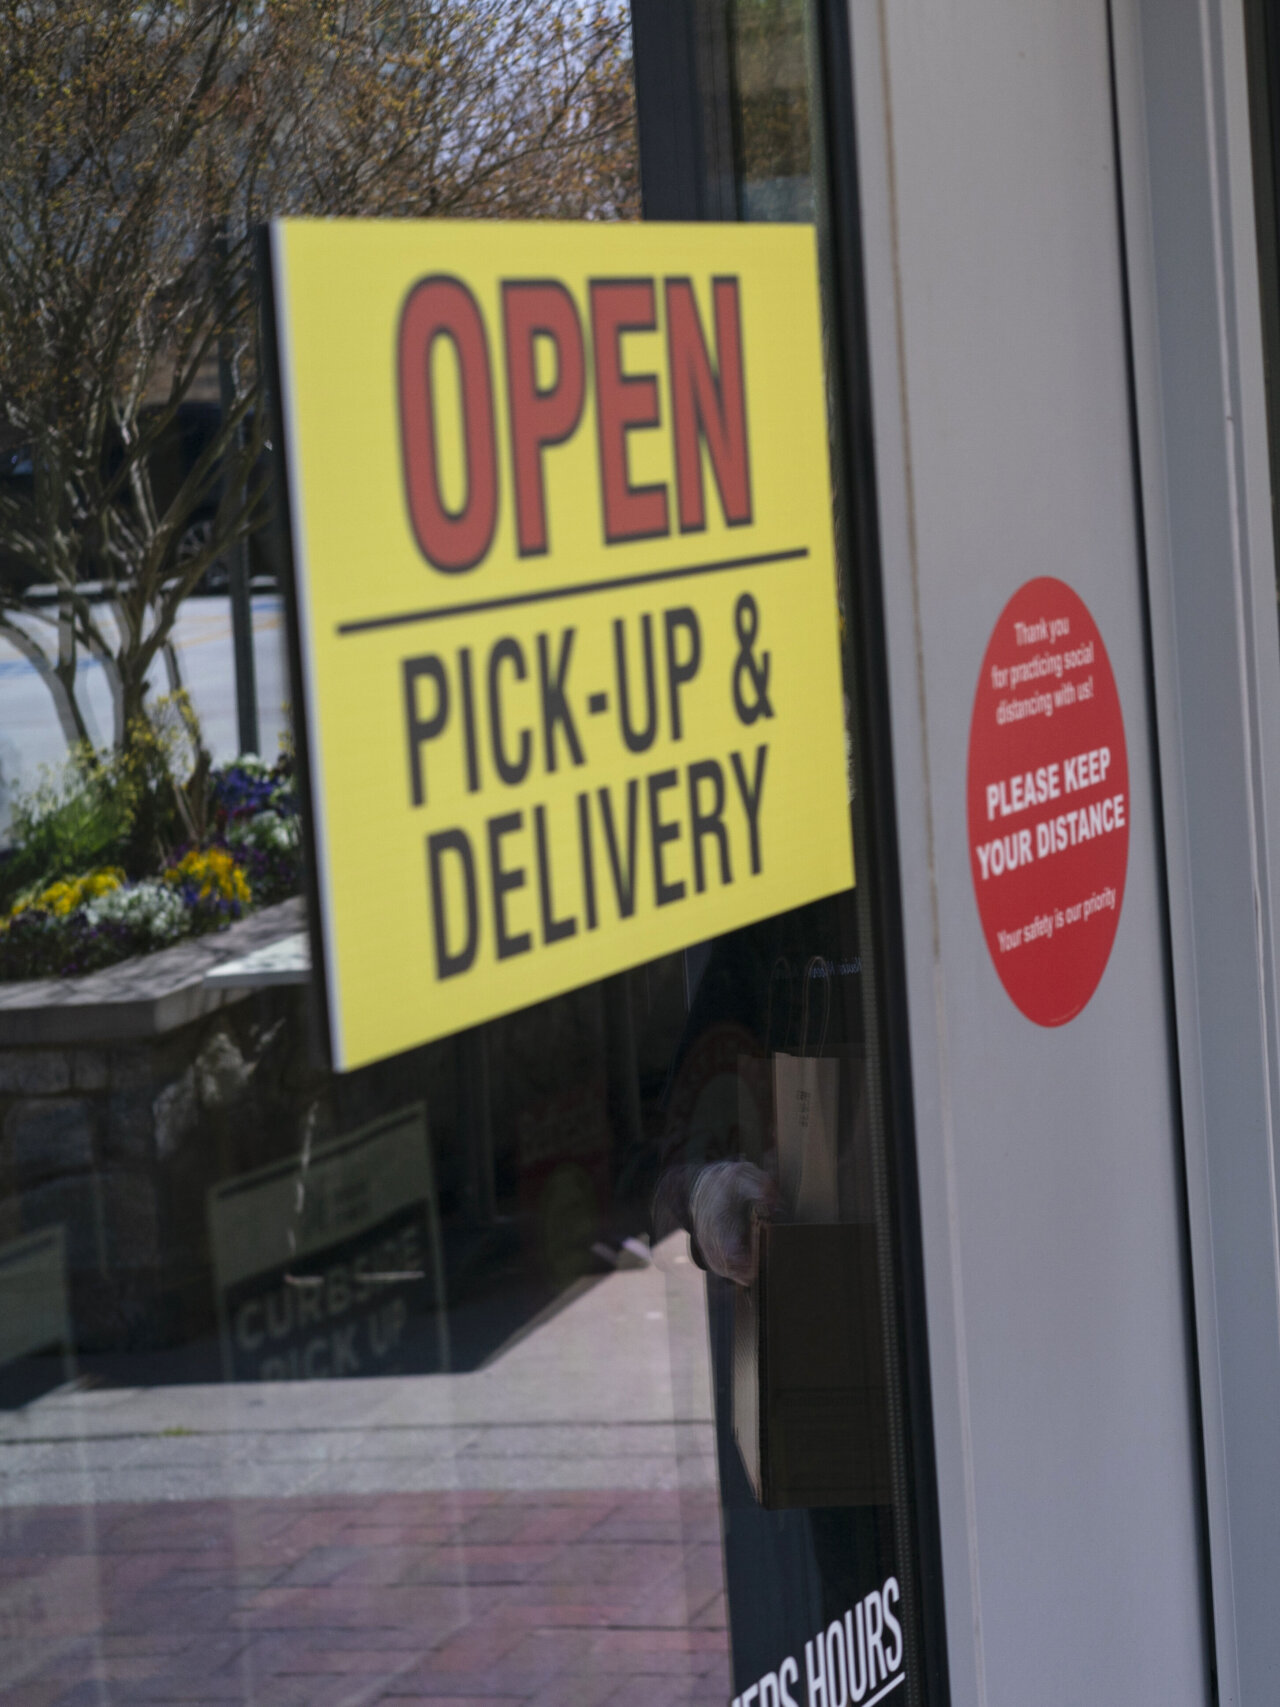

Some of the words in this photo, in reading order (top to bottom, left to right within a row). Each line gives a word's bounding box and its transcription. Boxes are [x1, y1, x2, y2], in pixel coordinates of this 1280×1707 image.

[396, 271, 754, 575] OPEN
[991, 664, 1009, 690] for
[1009, 651, 1063, 691] practicing
[1063, 640, 1094, 670] social
[1013, 616, 1048, 647] Thank
[1048, 616, 1070, 645] you
[402, 605, 702, 809] PICK-UP
[731, 591, 776, 727] &
[996, 690, 1053, 725] distancing
[1053, 681, 1076, 708] with
[1076, 675, 1094, 702] us!
[986, 763, 1061, 822] PLEASE
[1063, 746, 1111, 794] KEEP
[425, 743, 770, 983] DELIVERY
[976, 828, 1034, 881] YOUR
[1036, 793, 1126, 860] DISTANCE
[997, 929, 1023, 953] Your
[1023, 914, 1053, 942] safety
[1054, 908, 1065, 929] is
[1065, 902, 1083, 924] our
[1083, 886, 1116, 922] priority
[805, 1576, 903, 1707] HOURS
